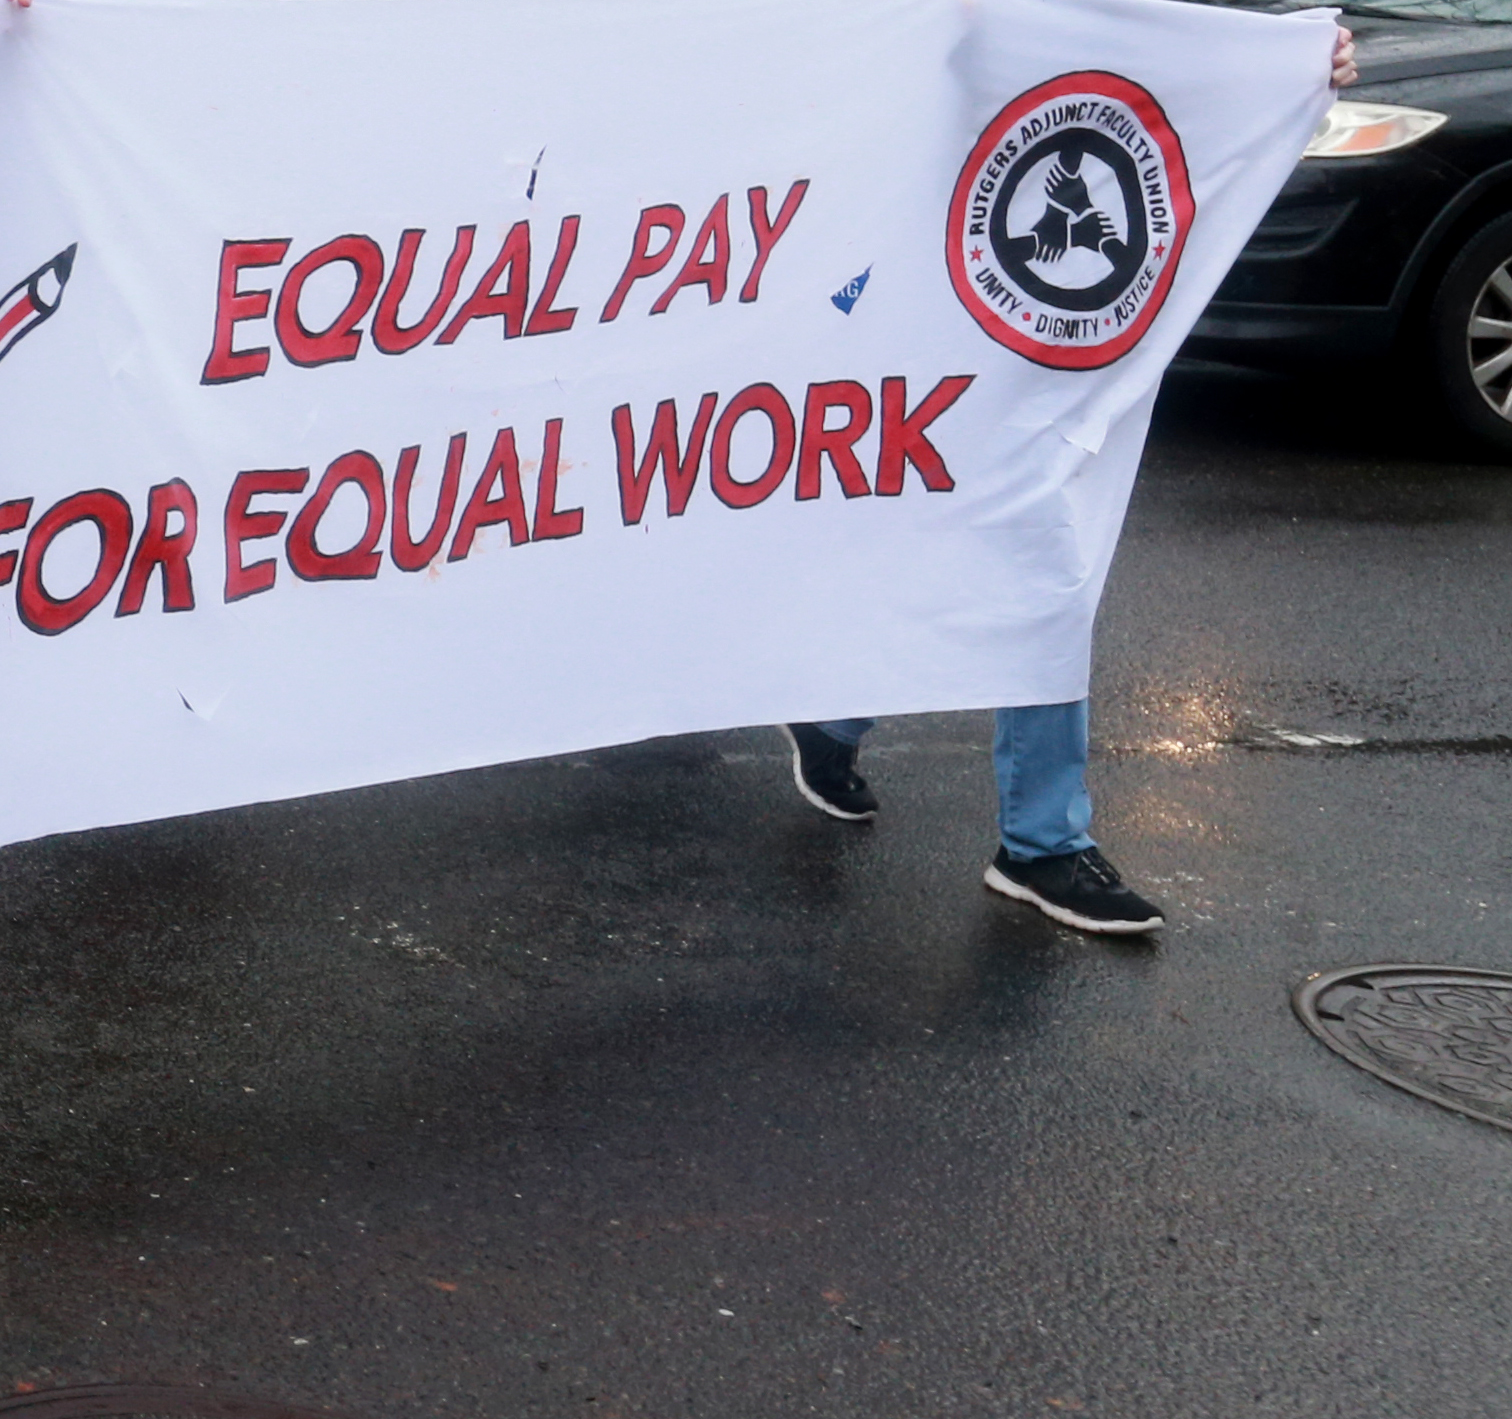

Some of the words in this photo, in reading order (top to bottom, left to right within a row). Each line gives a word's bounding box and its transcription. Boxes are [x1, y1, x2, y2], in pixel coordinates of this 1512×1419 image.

[969, 139, 1018, 235] RUTGERS
[1019, 102, 1098, 145] ADJUNCT
[1097, 103, 1152, 164] FACULTY
[1142, 166, 1170, 235] UNION
[200, 215, 581, 386] EQUAL
[600, 180, 810, 323] PAY
[976, 267, 1023, 315] UNITY
[1035, 314, 1099, 339] DIGNITY
[1111, 266, 1156, 327] JUSTICE
[224, 418, 584, 602] EQUAL
[612, 374, 976, 526] WORK
